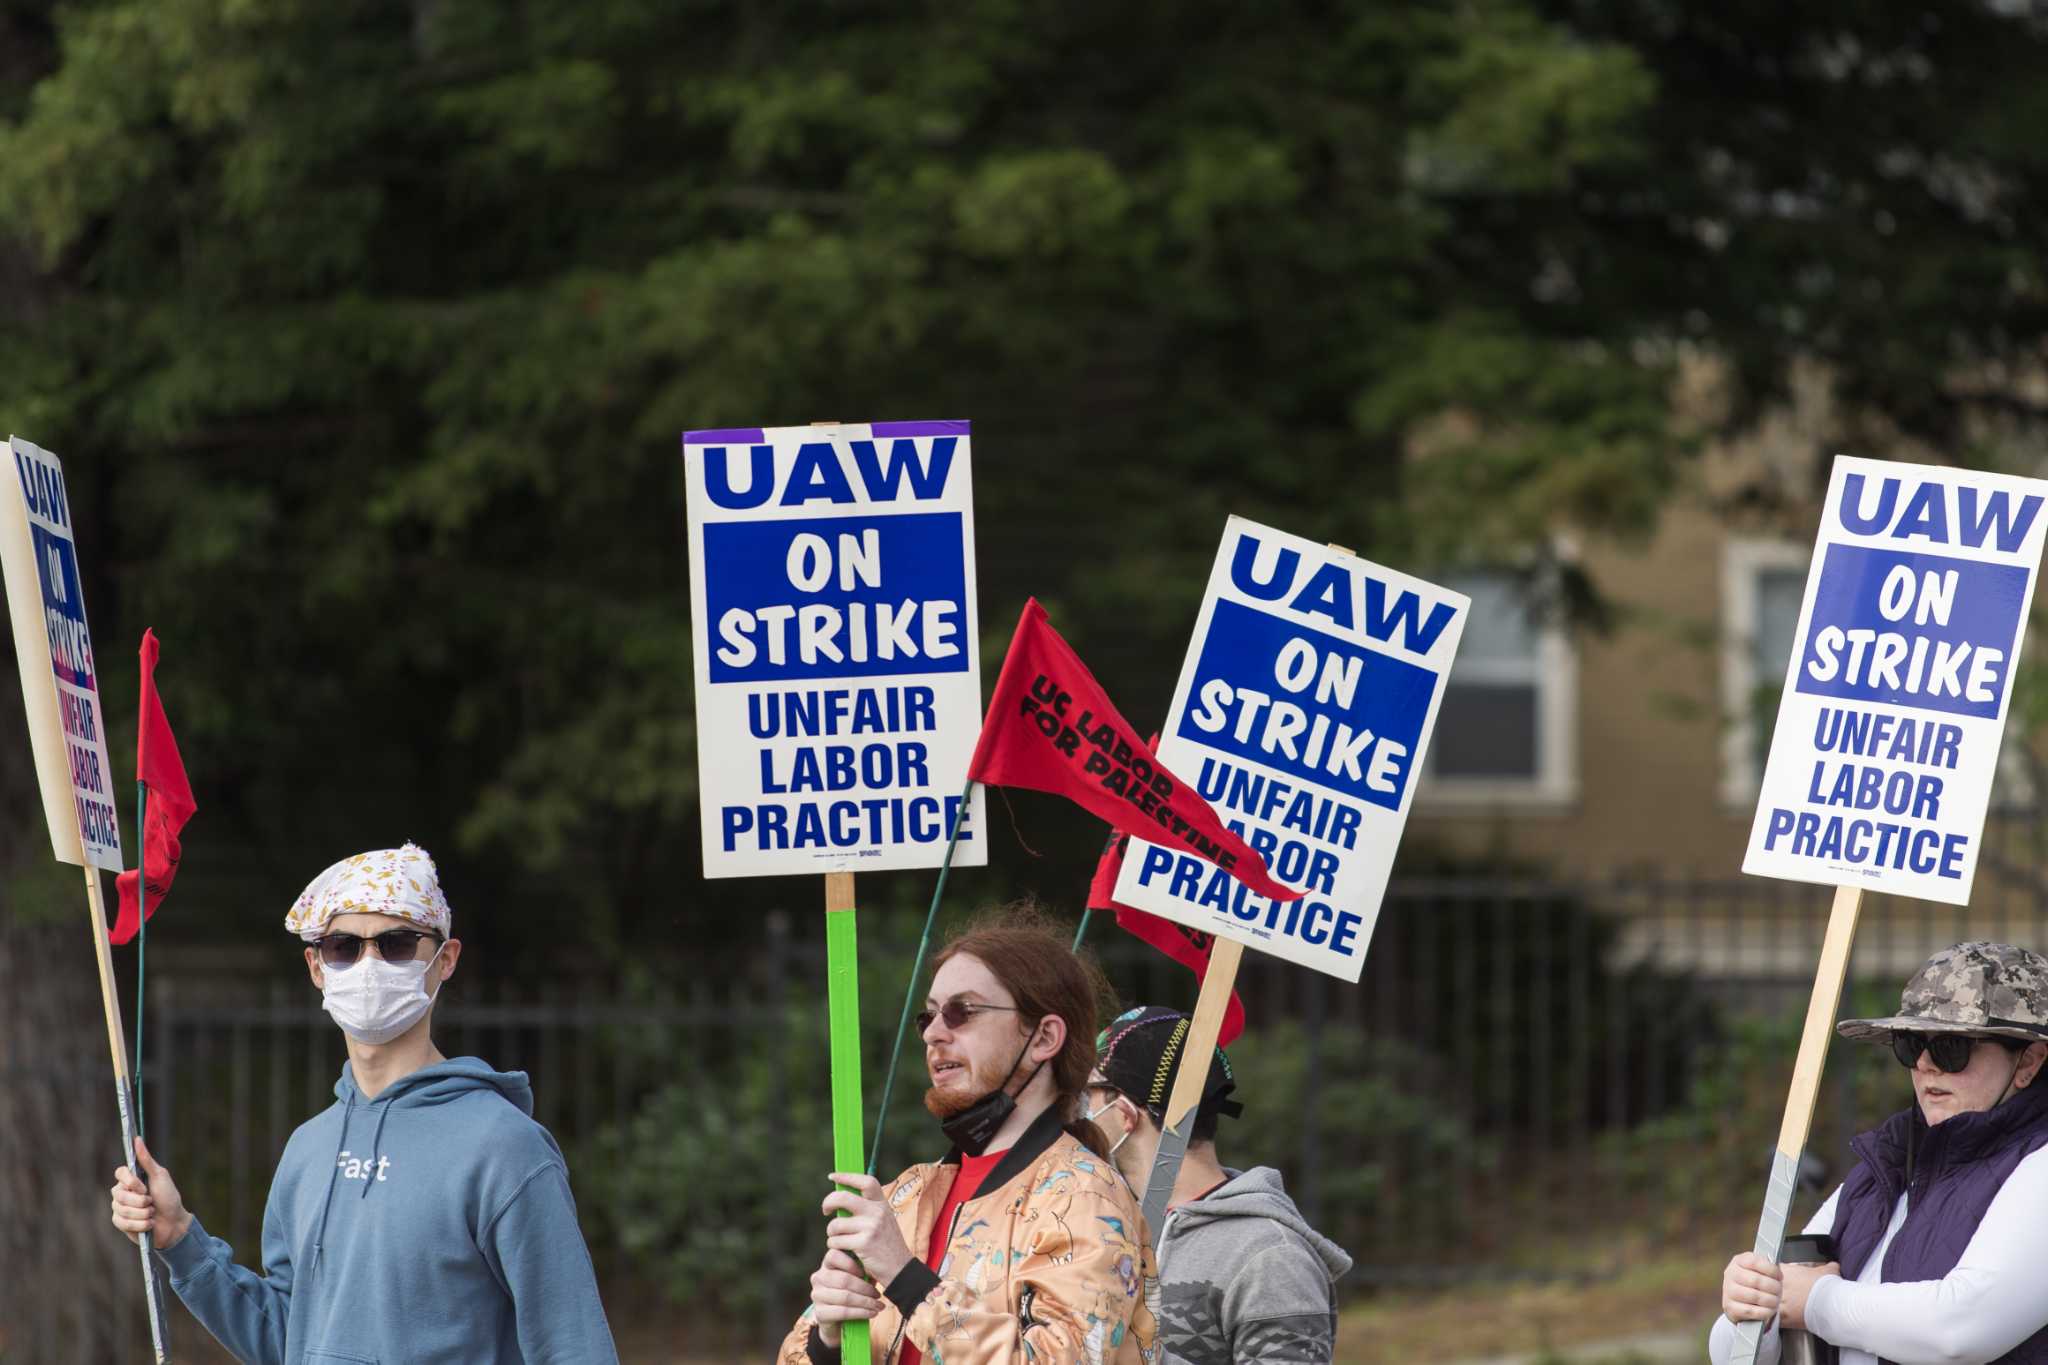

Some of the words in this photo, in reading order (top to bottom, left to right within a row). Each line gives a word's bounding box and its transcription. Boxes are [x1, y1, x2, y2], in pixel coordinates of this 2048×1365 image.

[15, 452, 67, 528] UAW
[703, 437, 958, 510] UAW
[1839, 473, 2045, 553] UAW
[47, 543, 67, 603] ON
[786, 529, 881, 593] ON
[1231, 533, 1457, 656] UAW
[1879, 564, 1959, 627] ON
[46, 605, 92, 676] STRIKE
[717, 598, 959, 669] STRIKE
[1807, 624, 2003, 703] STRIKE
[1031, 674, 1072, 717] UC
[1274, 637, 1363, 710] ON
[60, 687, 97, 742] UNFAIR
[748, 686, 936, 739] UNFAIR
[1191, 678, 1407, 794] STRIKE
[1813, 707, 1964, 770] UNFAIR
[67, 743, 104, 794] LABOR
[760, 742, 929, 794] LABOR
[1020, 694, 1080, 758] FOR
[1083, 751, 1237, 870] PALESTINE
[1196, 757, 1362, 850] UNFAIR
[1807, 760, 1944, 821] LABOR
[75, 794, 118, 848] ACTICE
[722, 795, 973, 852] PRACTICE
[1764, 807, 1969, 880] PRACTICE
[1226, 819, 1340, 896] BOR
